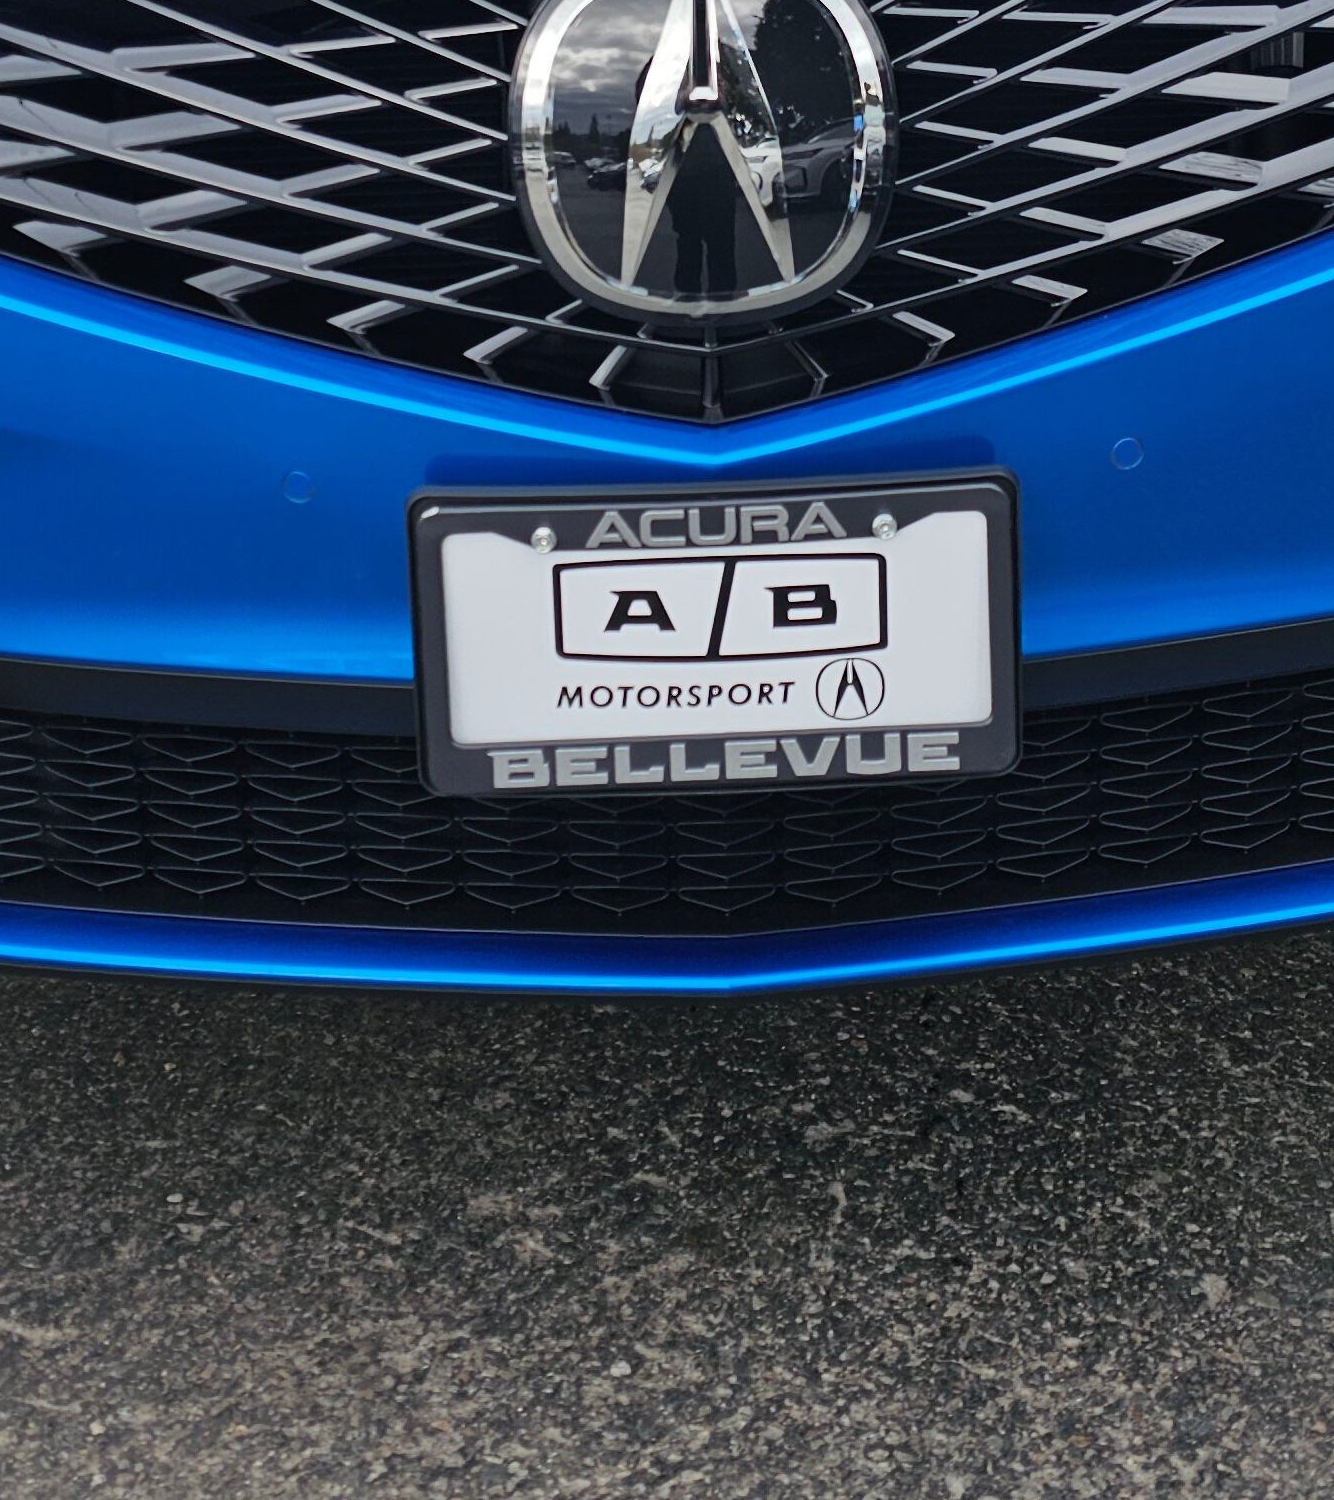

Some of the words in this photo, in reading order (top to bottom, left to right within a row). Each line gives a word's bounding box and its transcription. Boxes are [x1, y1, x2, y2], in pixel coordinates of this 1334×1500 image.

[585, 501, 847, 549] ACURA
[556, 681, 796, 710] MOTORSPORT
[486, 731, 961, 790] BELLEVUE
